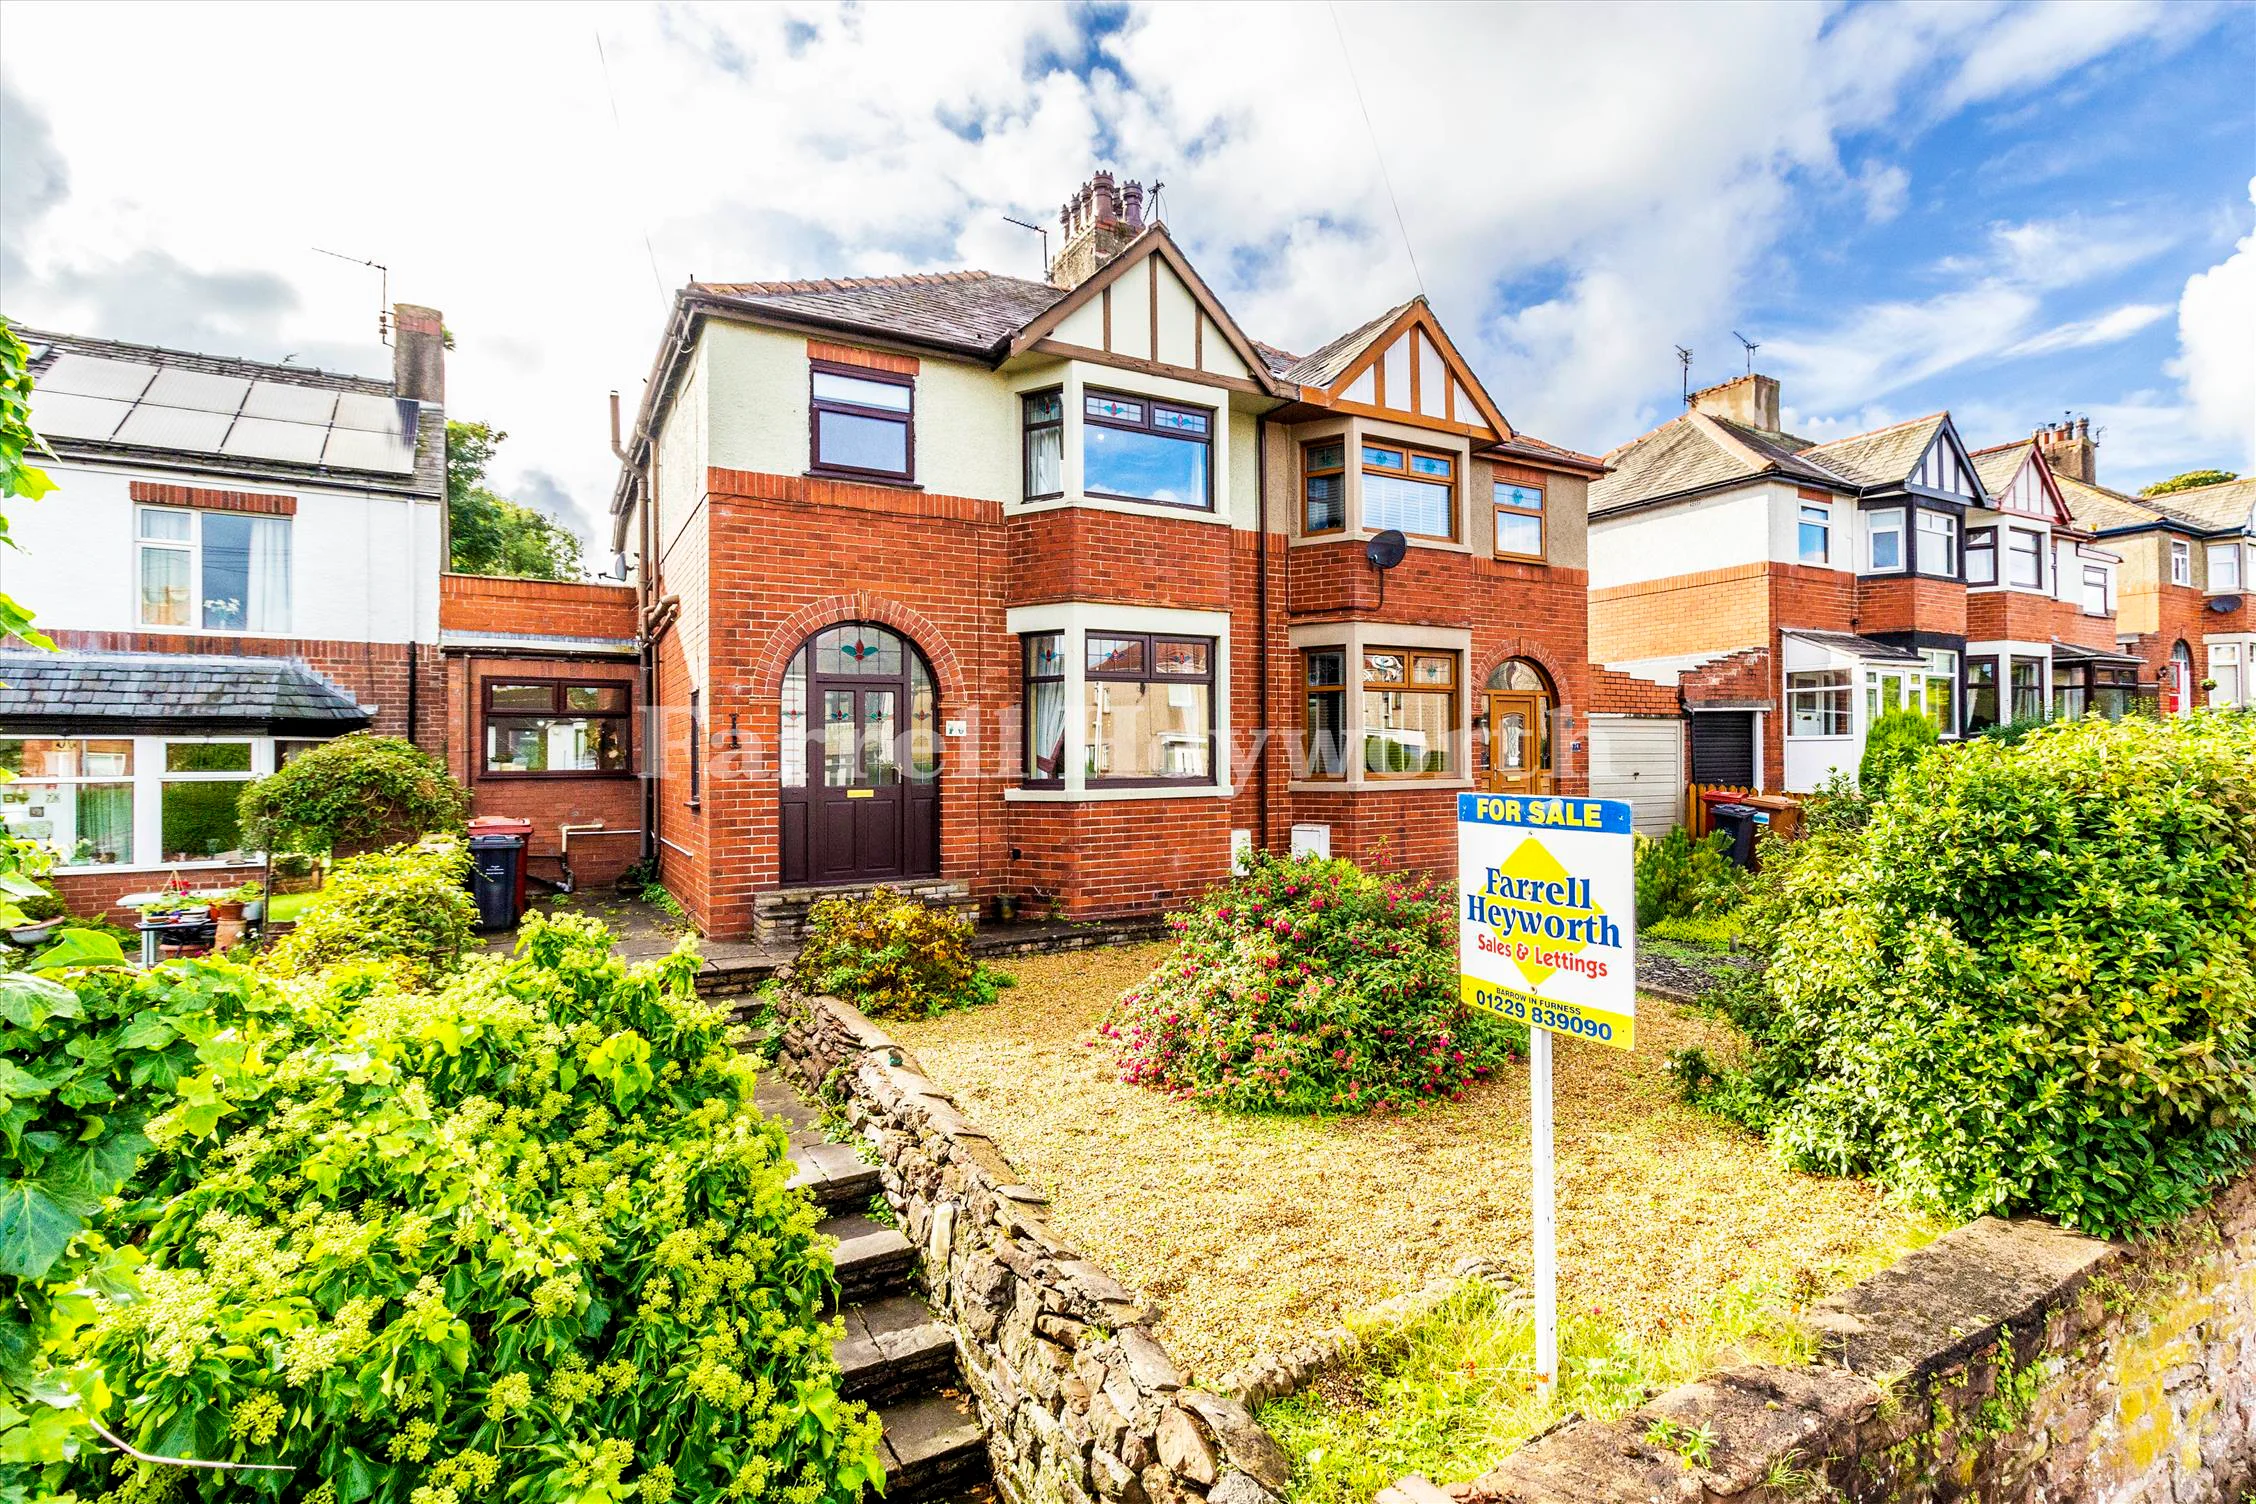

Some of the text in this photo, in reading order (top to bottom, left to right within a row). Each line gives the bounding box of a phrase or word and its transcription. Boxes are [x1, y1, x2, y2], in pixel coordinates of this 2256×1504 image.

[1476, 798, 1602, 828] FOR SALE
[1486, 866, 1592, 909] Farrell
[1467, 894, 1622, 948] Heyworth
[1478, 933, 1608, 979] Sales & Lettings
[1476, 989, 1612, 1041] 01229 839090
[1496, 987, 1581, 1015] BARROW IN FURNESS
